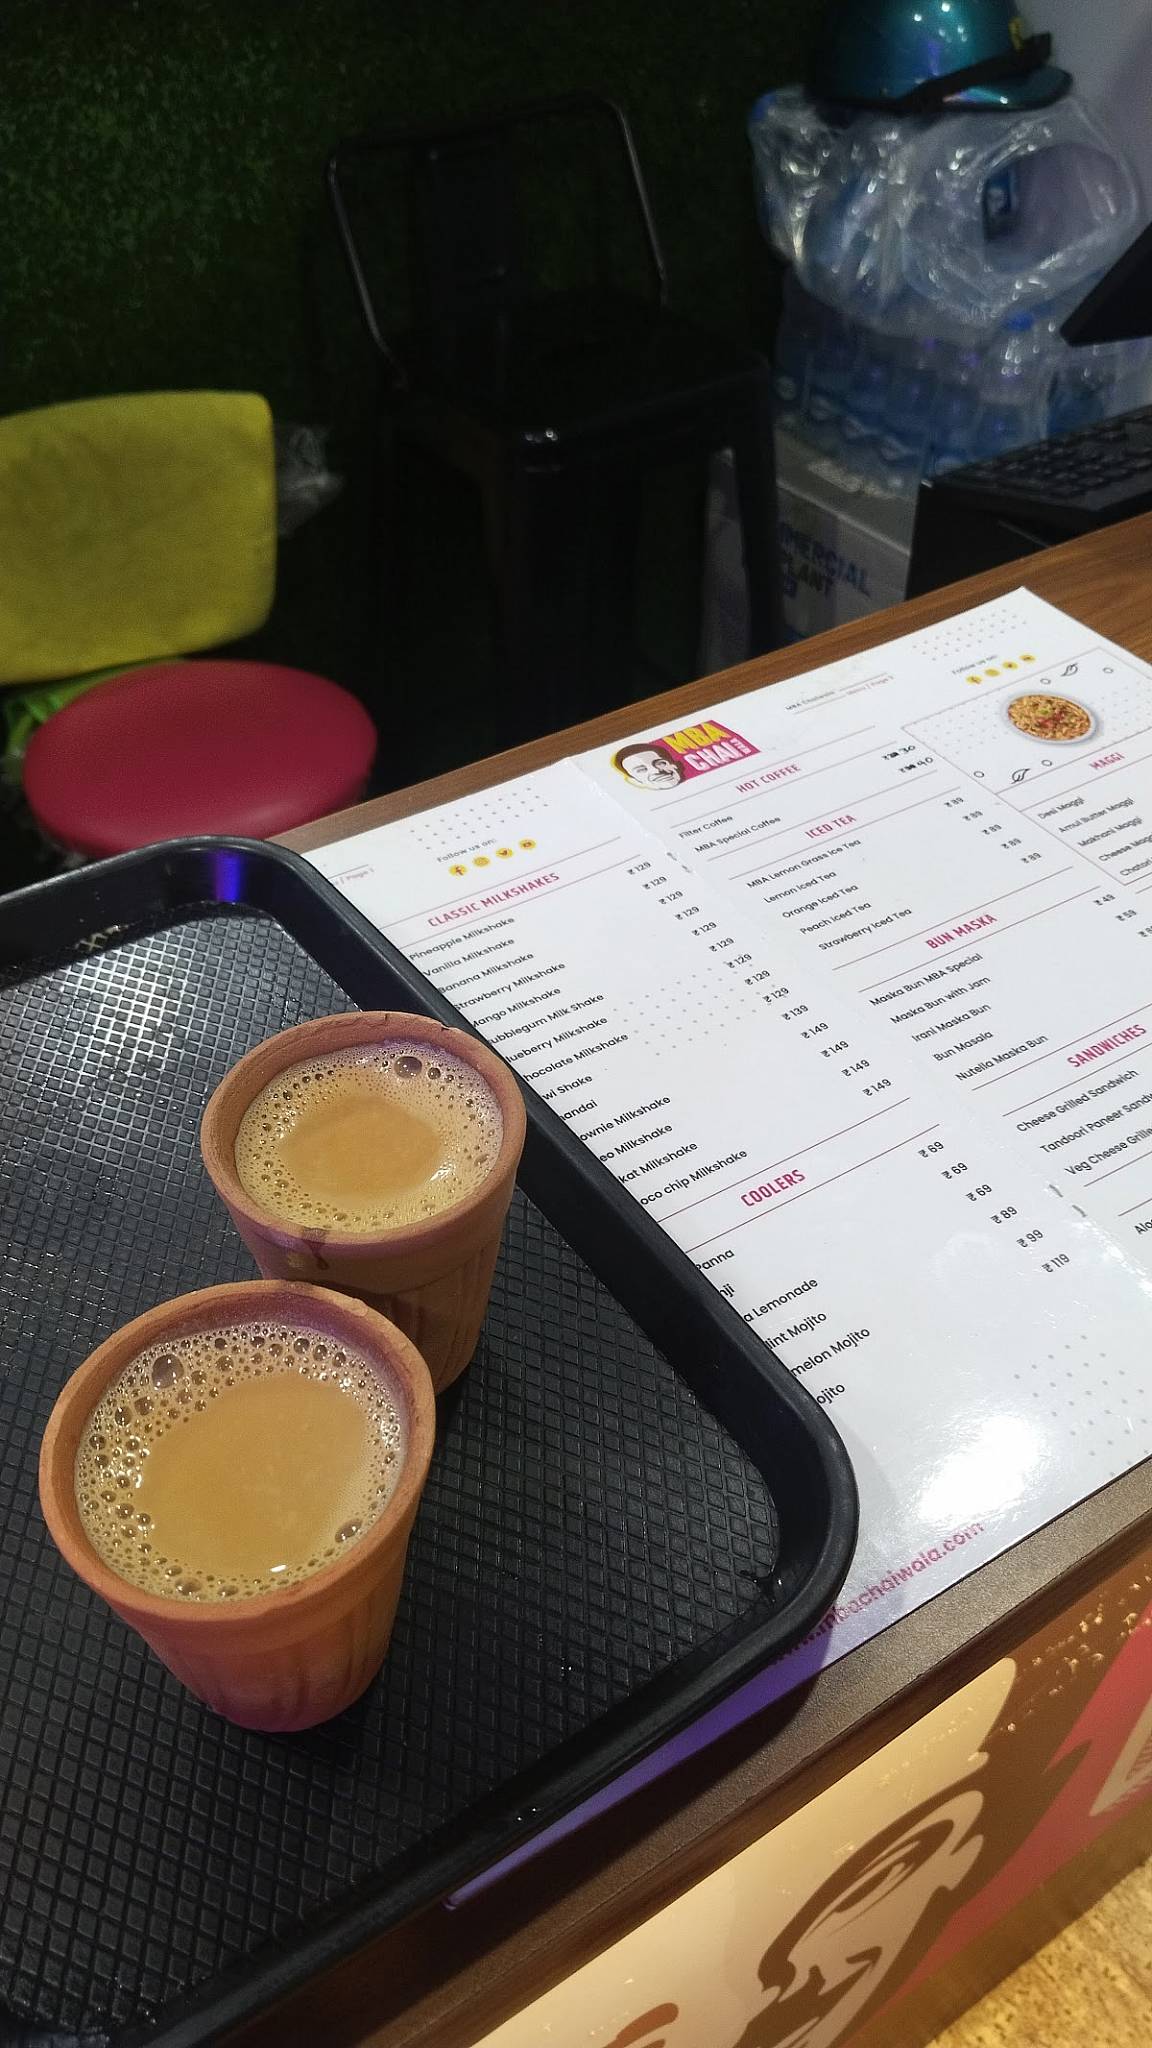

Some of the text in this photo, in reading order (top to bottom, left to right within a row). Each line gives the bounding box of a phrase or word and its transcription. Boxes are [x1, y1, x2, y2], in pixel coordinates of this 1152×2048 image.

[662, 723, 732, 754] MBA
[684, 741, 742, 770] CHAI
[736, 764, 800, 793] HOT COFFEE
[1089, 752, 1125, 770] MAGGI
[679, 816, 733, 839] Filter Coffee
[694, 817, 781, 853] MBA Special Coffee
[805, 815, 856, 839] ICED TEA
[437, 849, 467, 863] Follow
[746, 840, 861, 888] MBA Lemon Grass Ice Tea
[428, 873, 560, 927] CLASSIC MILKSHAKES
[763, 872, 837, 903] Lemon Iced Tea
[782, 885, 859, 918] Orange Iced Tea
[800, 903, 872, 934] Peach Iced Tea
[818, 909, 912, 950] Strawberry Iced Tea
[925, 914, 997, 949] BUN MASKA
[408, 918, 515, 961] Pineapple Milkshake
[422, 939, 514, 976] Vanilla Milkshake
[438, 954, 534, 993] Banana Milkshake
[454, 964, 565, 1011] Strawberry Milkshake
[869, 953, 983, 1006] Maska Bun MBA Special
[507, 989, 561, 1013] Milkshake
[890, 977, 991, 1024] Maska Bun with Jam
[489, 995, 604, 1044] ubblegum Milk Shake
[911, 1005, 991, 1042] Irani Maska Bun
[506, 1018, 608, 1062] lueberry Milkshake
[524, 1035, 628, 1082] hocolate Milkshake
[933, 1032, 993, 1061] Bun Masala
[955, 1036, 1048, 1081] Nutella Maska Bun
[1067, 1024, 1147, 1067] SANDWICHES
[542, 1076, 593, 1100] wi Shake
[1016, 1070, 1139, 1132] Cheese Grilled Sandwich
[560, 1099, 598, 1121] andai
[579, 1097, 671, 1141] ownie Milkshake
[599, 1125, 672, 1163] eo Milkshake
[1039, 1126, 1089, 1153] Tandoori
[1085, 1110, 1124, 1131] Paneer
[619, 1143, 698, 1184] kat Milkshake
[1064, 1161, 1092, 1175] Veg
[1088, 1142, 1128, 1164] Cheese
[640, 1151, 747, 1205] oco chip Milkshake
[741, 1169, 805, 1207] COOLERS
[1134, 1220, 1152, 1235] Alo
[752, 1280, 818, 1317] Lemonade
[765, 1313, 827, 1350] int Mojito
[790, 1329, 870, 1377] melon Mojito
[817, 1384, 845, 1404] ojito
